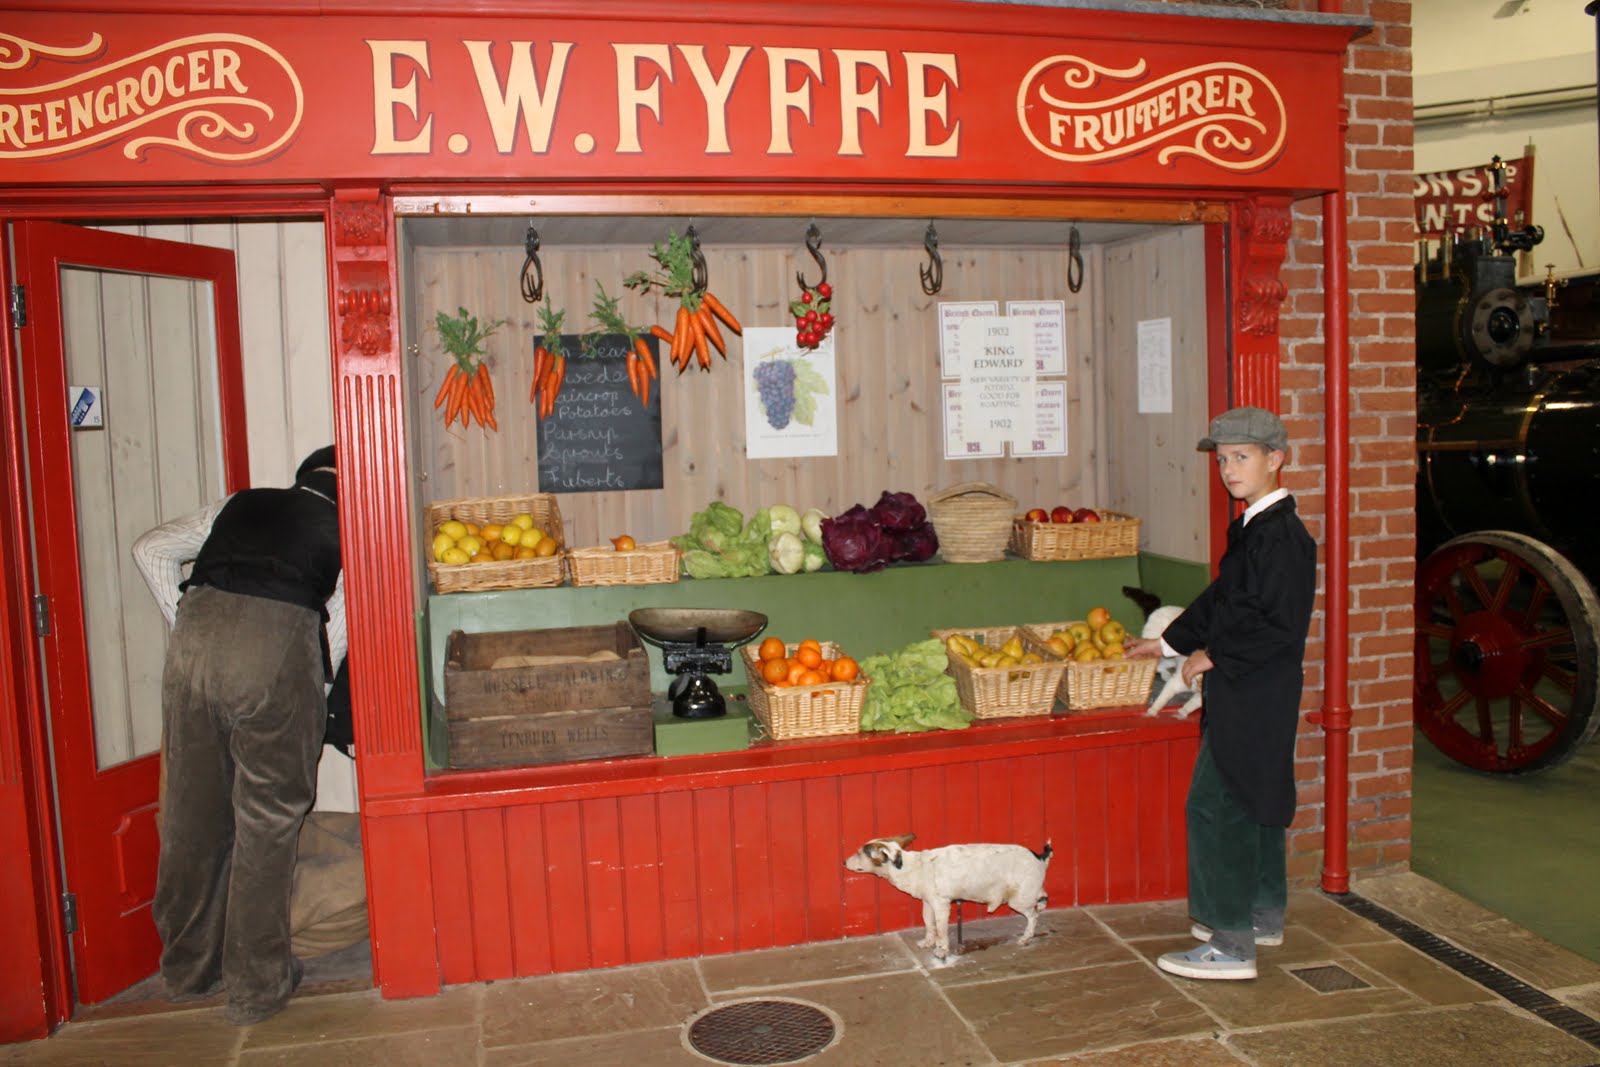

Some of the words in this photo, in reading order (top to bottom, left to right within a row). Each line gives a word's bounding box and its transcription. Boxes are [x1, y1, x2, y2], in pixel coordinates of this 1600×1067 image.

[0, 48, 249, 149] REENGROCER
[1048, 75, 1254, 152] FRUITERER
[987, 327, 1010, 336] 1902
[559, 404, 632, 420] Potatoes
[989, 418, 1013, 429] 1902
